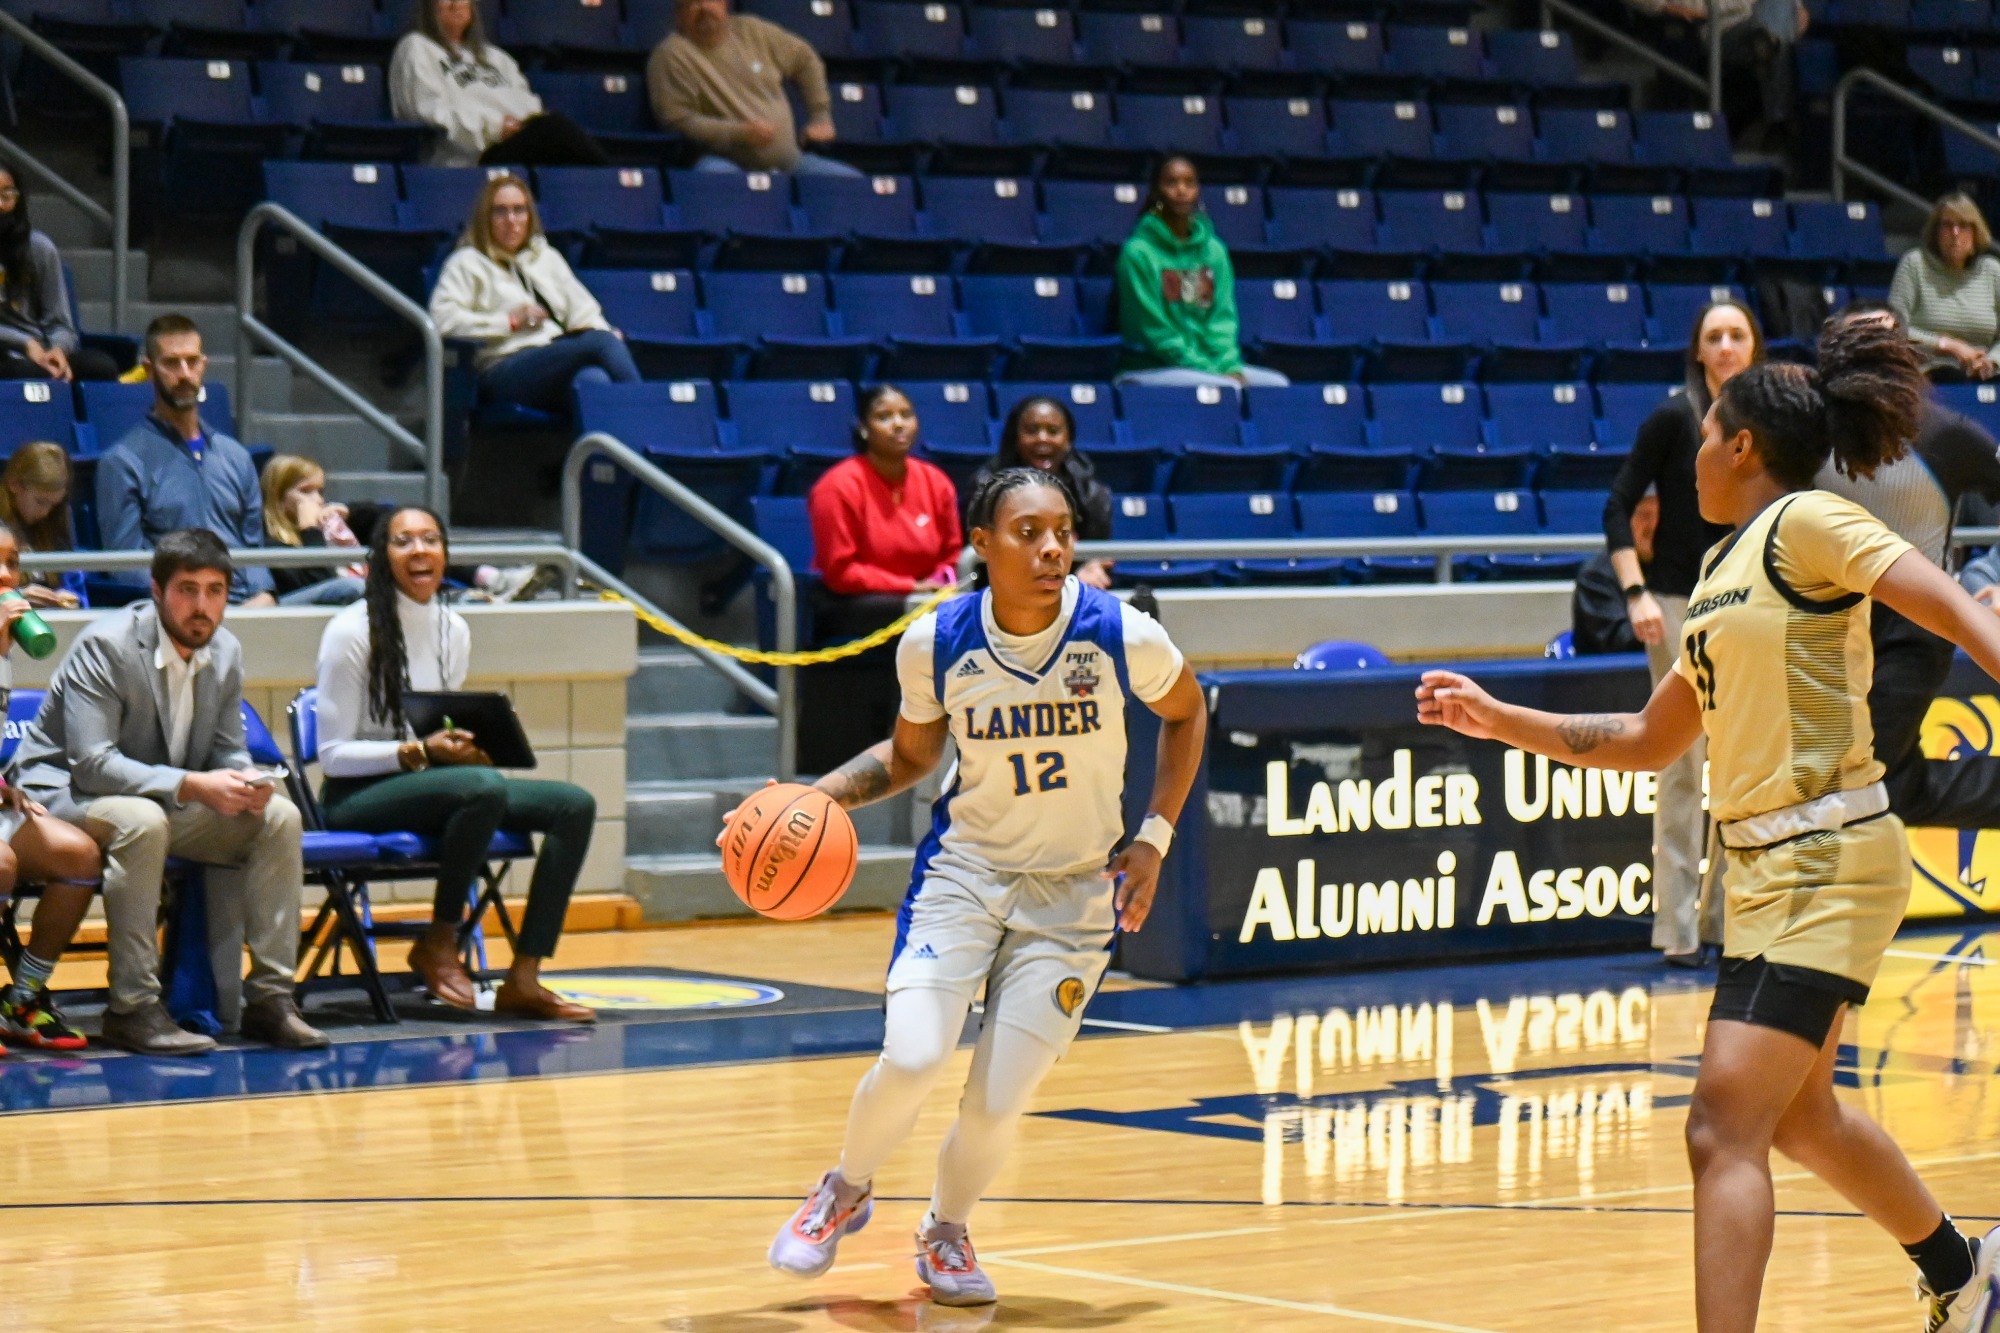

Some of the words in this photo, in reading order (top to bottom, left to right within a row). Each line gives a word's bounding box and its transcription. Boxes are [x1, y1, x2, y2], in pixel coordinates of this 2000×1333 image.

[965, 700, 1101, 740] LANDER
[1007, 750, 1068, 796] 12
[1503, 749, 1658, 823] UNIVE
[1476, 850, 1652, 926] ASSOC
